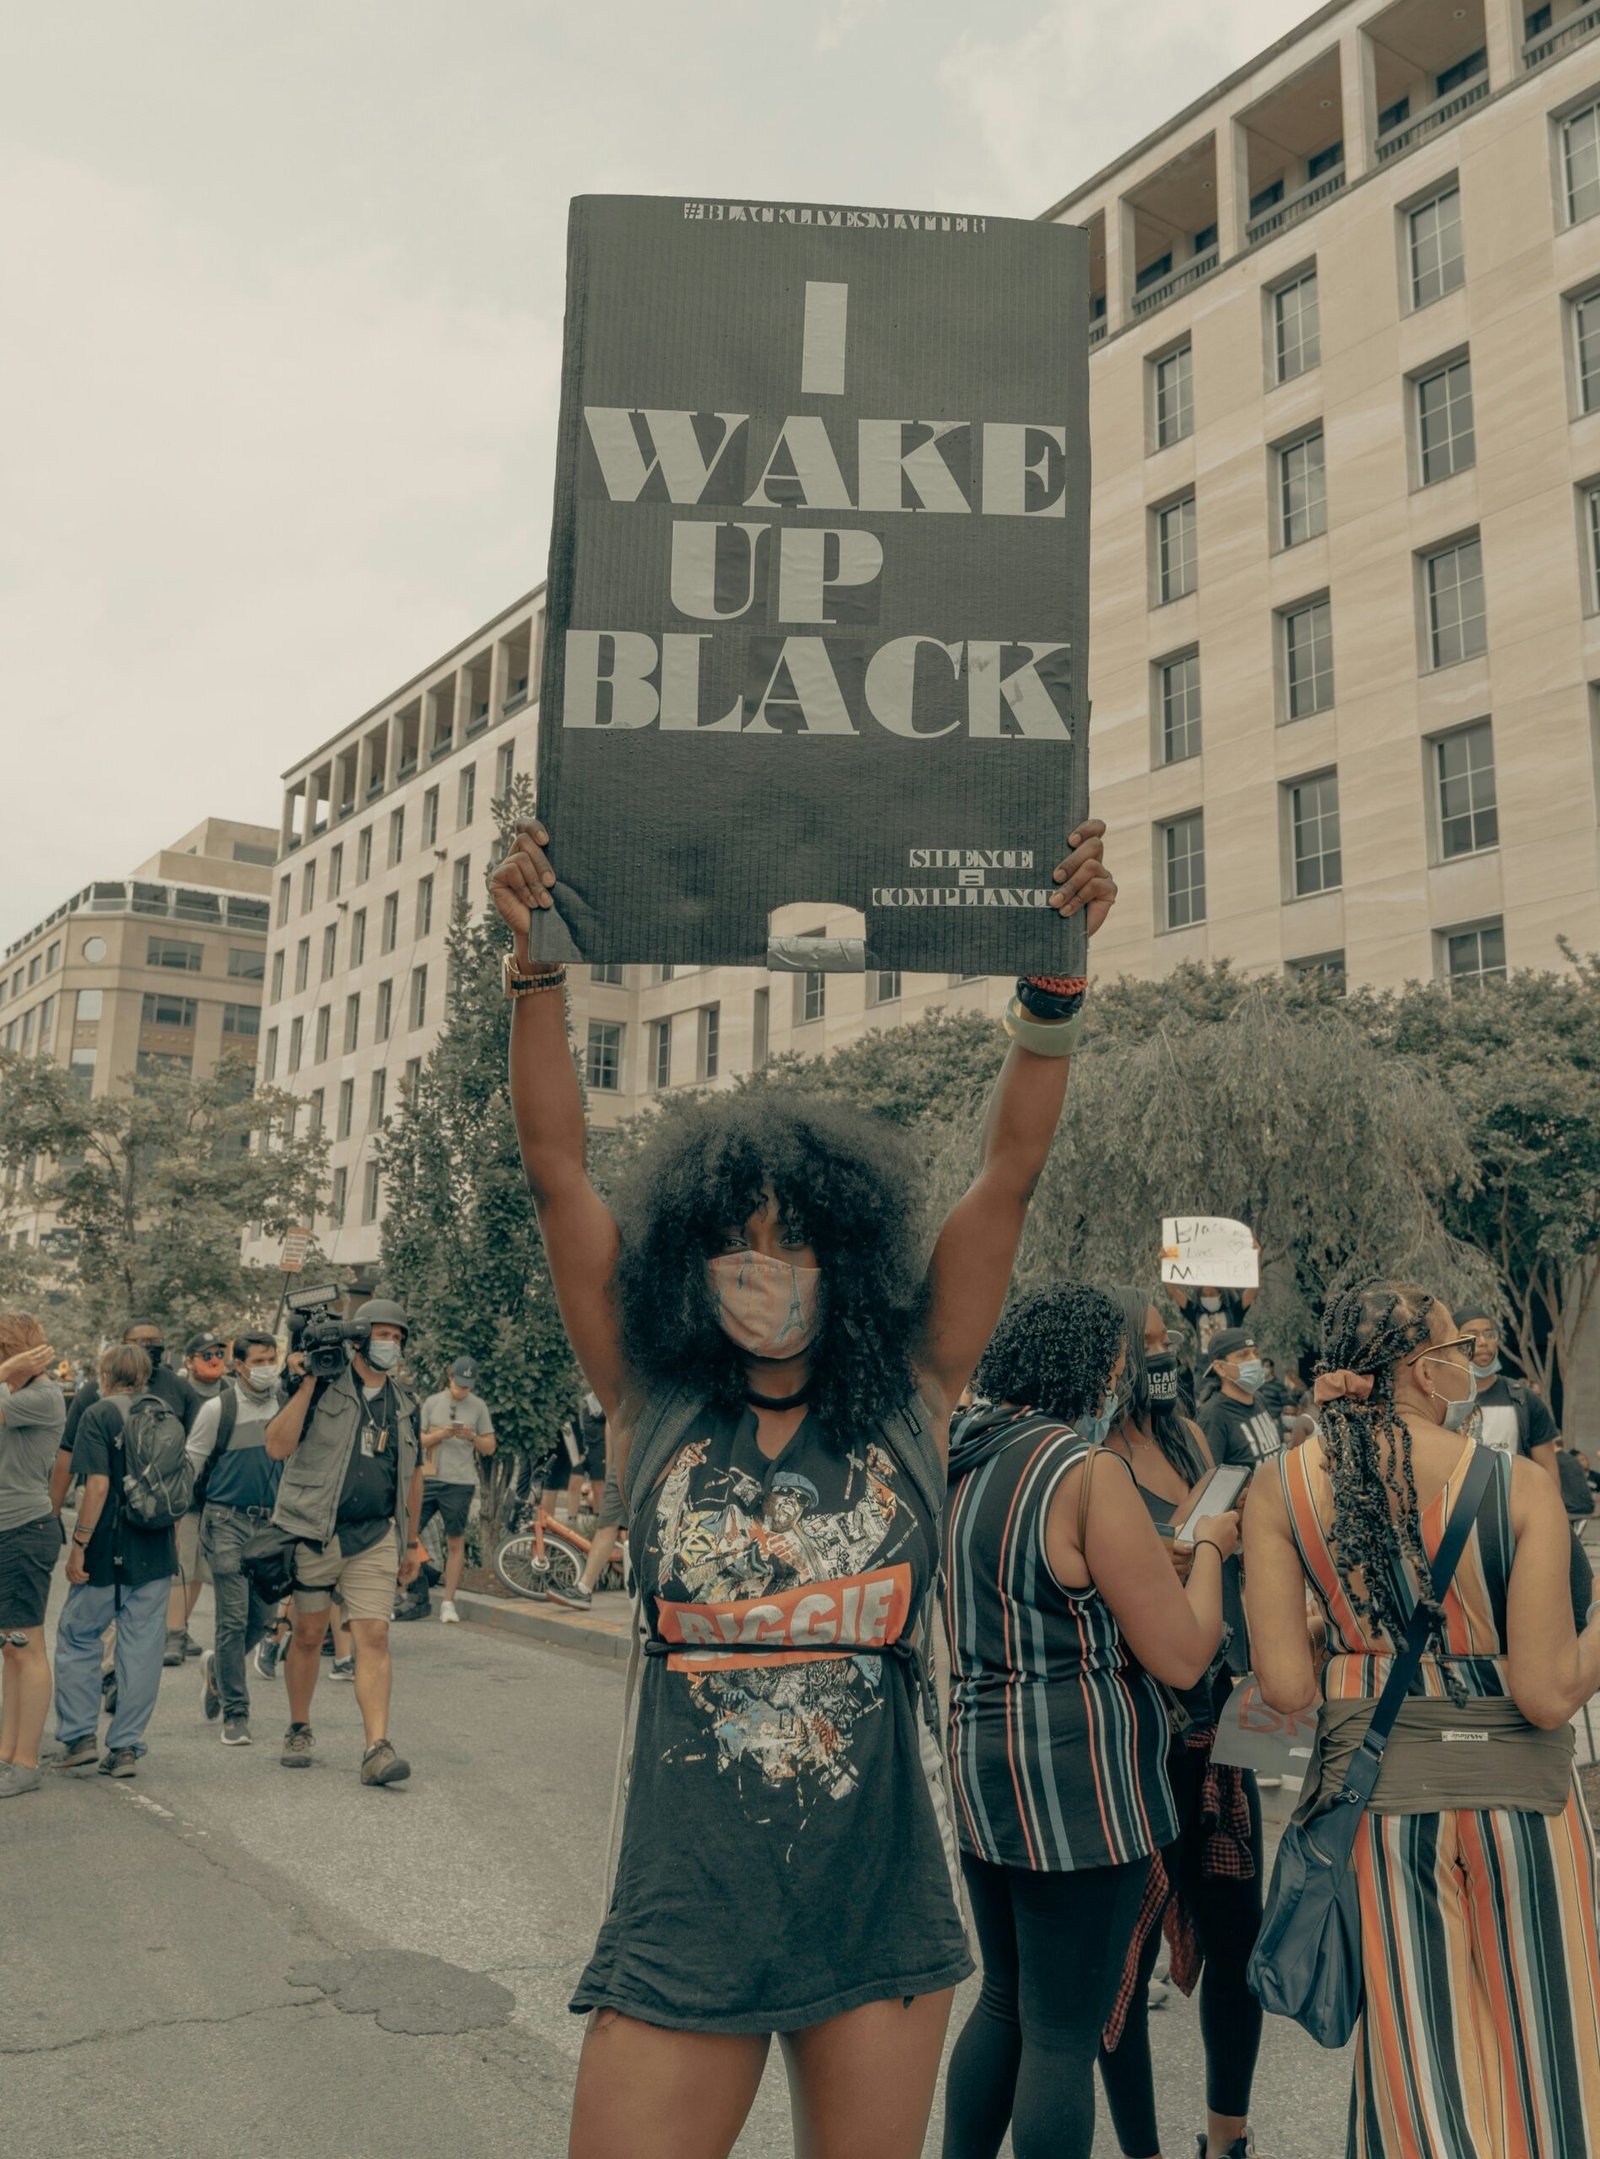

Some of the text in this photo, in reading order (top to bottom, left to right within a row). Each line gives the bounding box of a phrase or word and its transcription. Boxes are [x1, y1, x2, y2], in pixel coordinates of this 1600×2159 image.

[684, 203, 986, 233] #BLACKLIVESMATTER
[801, 281, 848, 395] I
[584, 406, 1066, 518] WAKE
[670, 521, 883, 624] UP
[563, 629, 1071, 741] BLACK
[911, 850, 1032, 868] SILENCE
[676, 1578, 894, 1662] BIGGIE
